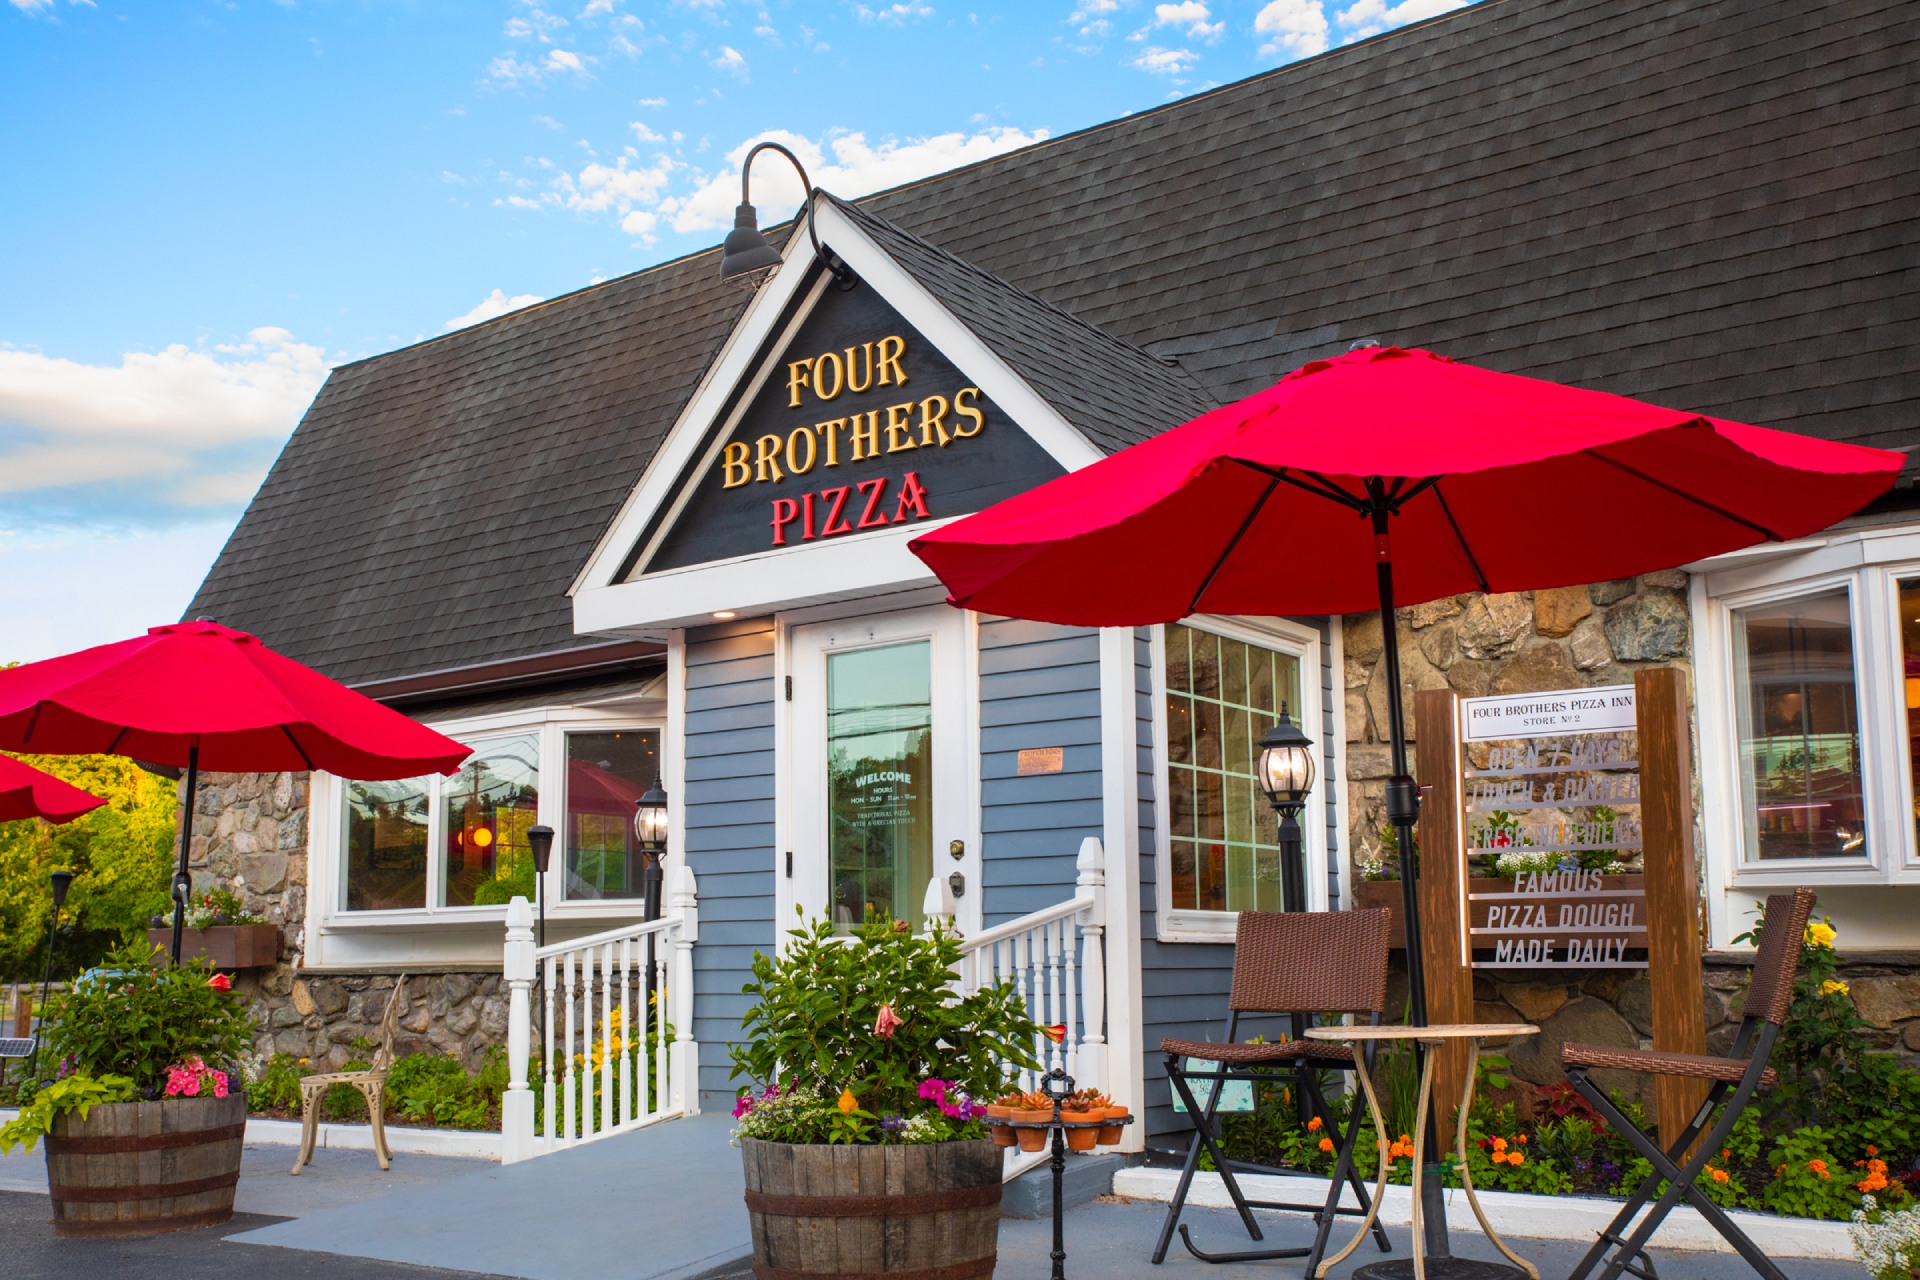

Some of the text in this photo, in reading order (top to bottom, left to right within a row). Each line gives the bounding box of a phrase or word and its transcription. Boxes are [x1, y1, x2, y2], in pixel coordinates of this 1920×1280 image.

[786, 335, 909, 408] FOUR
[721, 386, 985, 490] BROTHERS
[769, 471, 931, 546] PIZZA
[1473, 695, 1633, 719] FOUR BROTHERS PIZZA INN
[1523, 716, 1556, 726] STORE
[1574, 714, 1581, 723] 2
[1488, 739, 1620, 771] OPEN 7 DAYS
[855, 771, 912, 788] WELCOME
[1472, 775, 1639, 807] LUNCH & DINNER
[869, 795, 882, 803] SUN
[893, 809, 911, 817] PIZZA
[897, 817, 916, 825] TOUCH
[1473, 820, 1642, 849] FRESH INGREDIENTS
[1513, 868, 1604, 894] FAMOUS
[1487, 903, 1635, 928] PIZZA DOUGH
[1495, 938, 1628, 963] MADE DAILY
